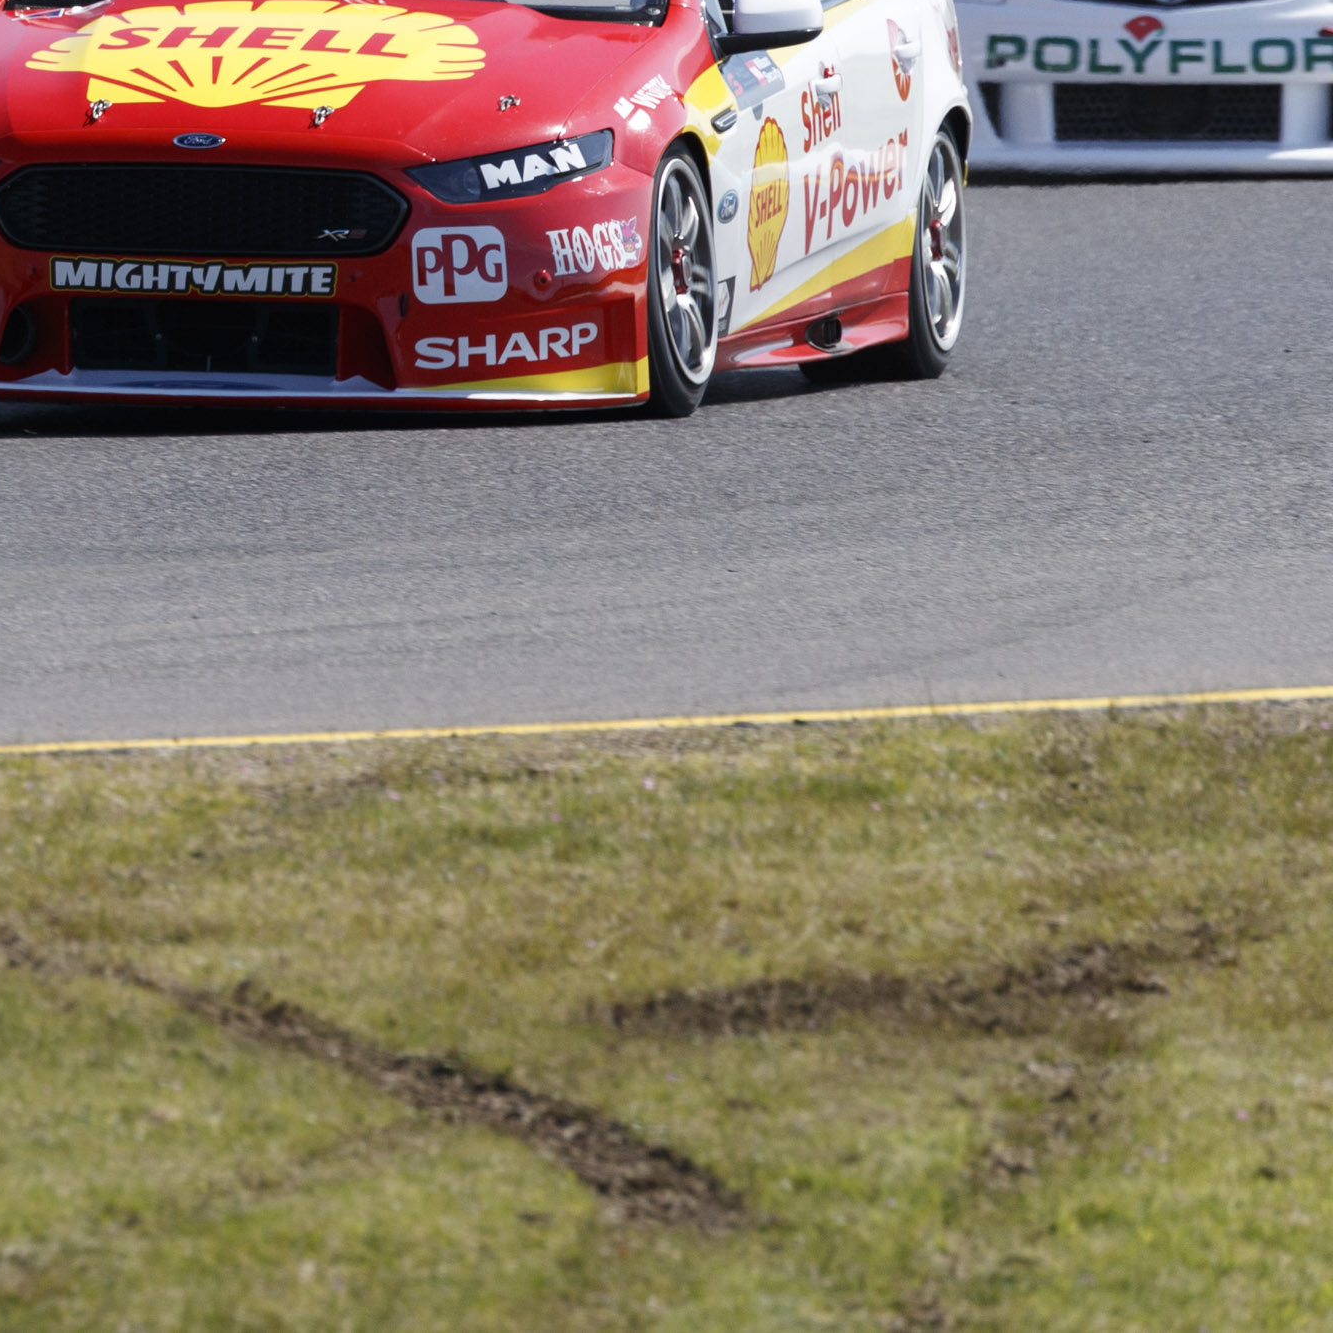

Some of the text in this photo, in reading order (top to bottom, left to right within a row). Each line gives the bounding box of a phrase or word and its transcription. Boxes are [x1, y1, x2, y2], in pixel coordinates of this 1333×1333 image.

[96, 24, 411, 60] SHELL
[984, 32, 1333, 75] POLYFLOR
[478, 141, 587, 191] MAN
[803, 128, 909, 256] V-Power
[415, 231, 504, 299] PPG
[413, 320, 599, 371] SHARP
